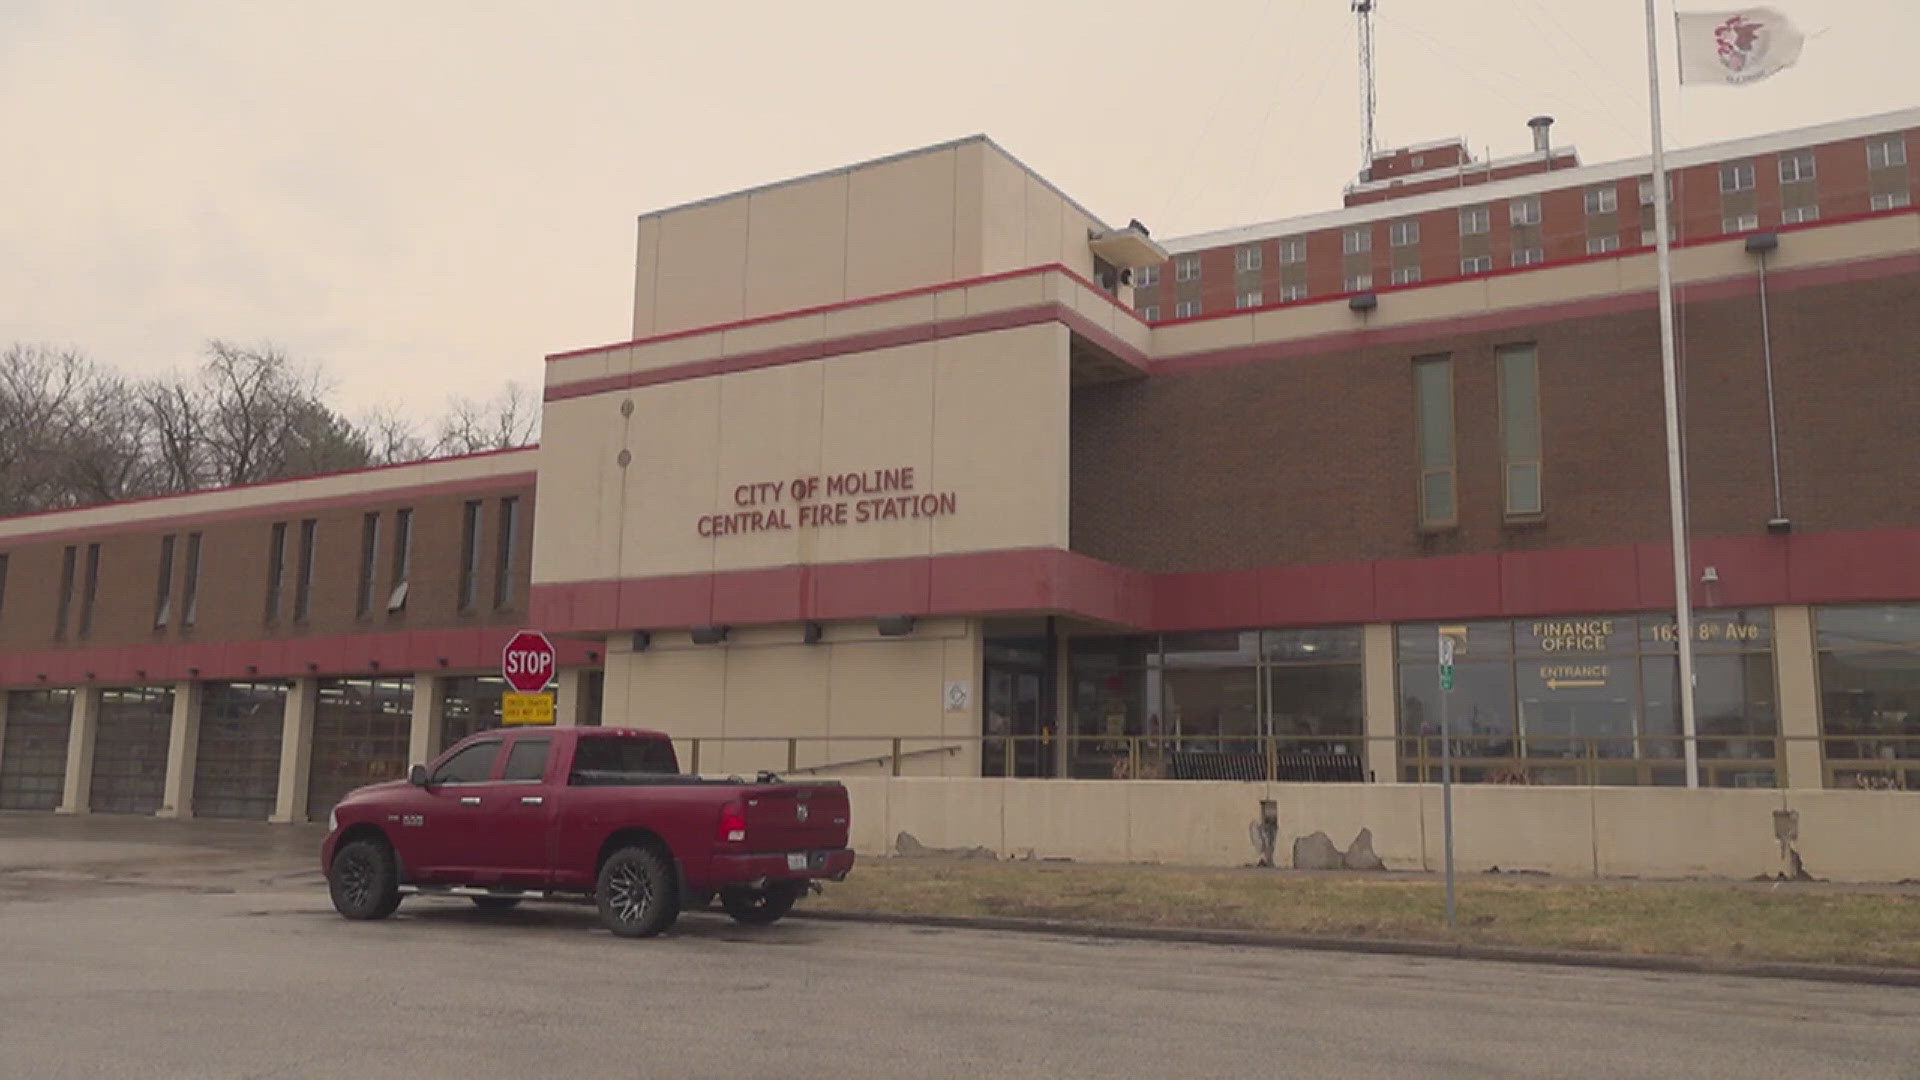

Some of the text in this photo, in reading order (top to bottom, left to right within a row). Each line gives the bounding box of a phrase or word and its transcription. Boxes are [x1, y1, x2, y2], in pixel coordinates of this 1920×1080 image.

[734, 467, 914, 507] CITY OF MOLINE
[697, 492, 956, 537] CENTRAL FIRE STATION
[1533, 621, 1614, 637] FINANCE
[1725, 622, 1759, 640] Ave
[1541, 635, 1606, 652] OFFICE
[507, 651, 551, 674] STOP
[1540, 665, 1610, 679] ENTRANCE
